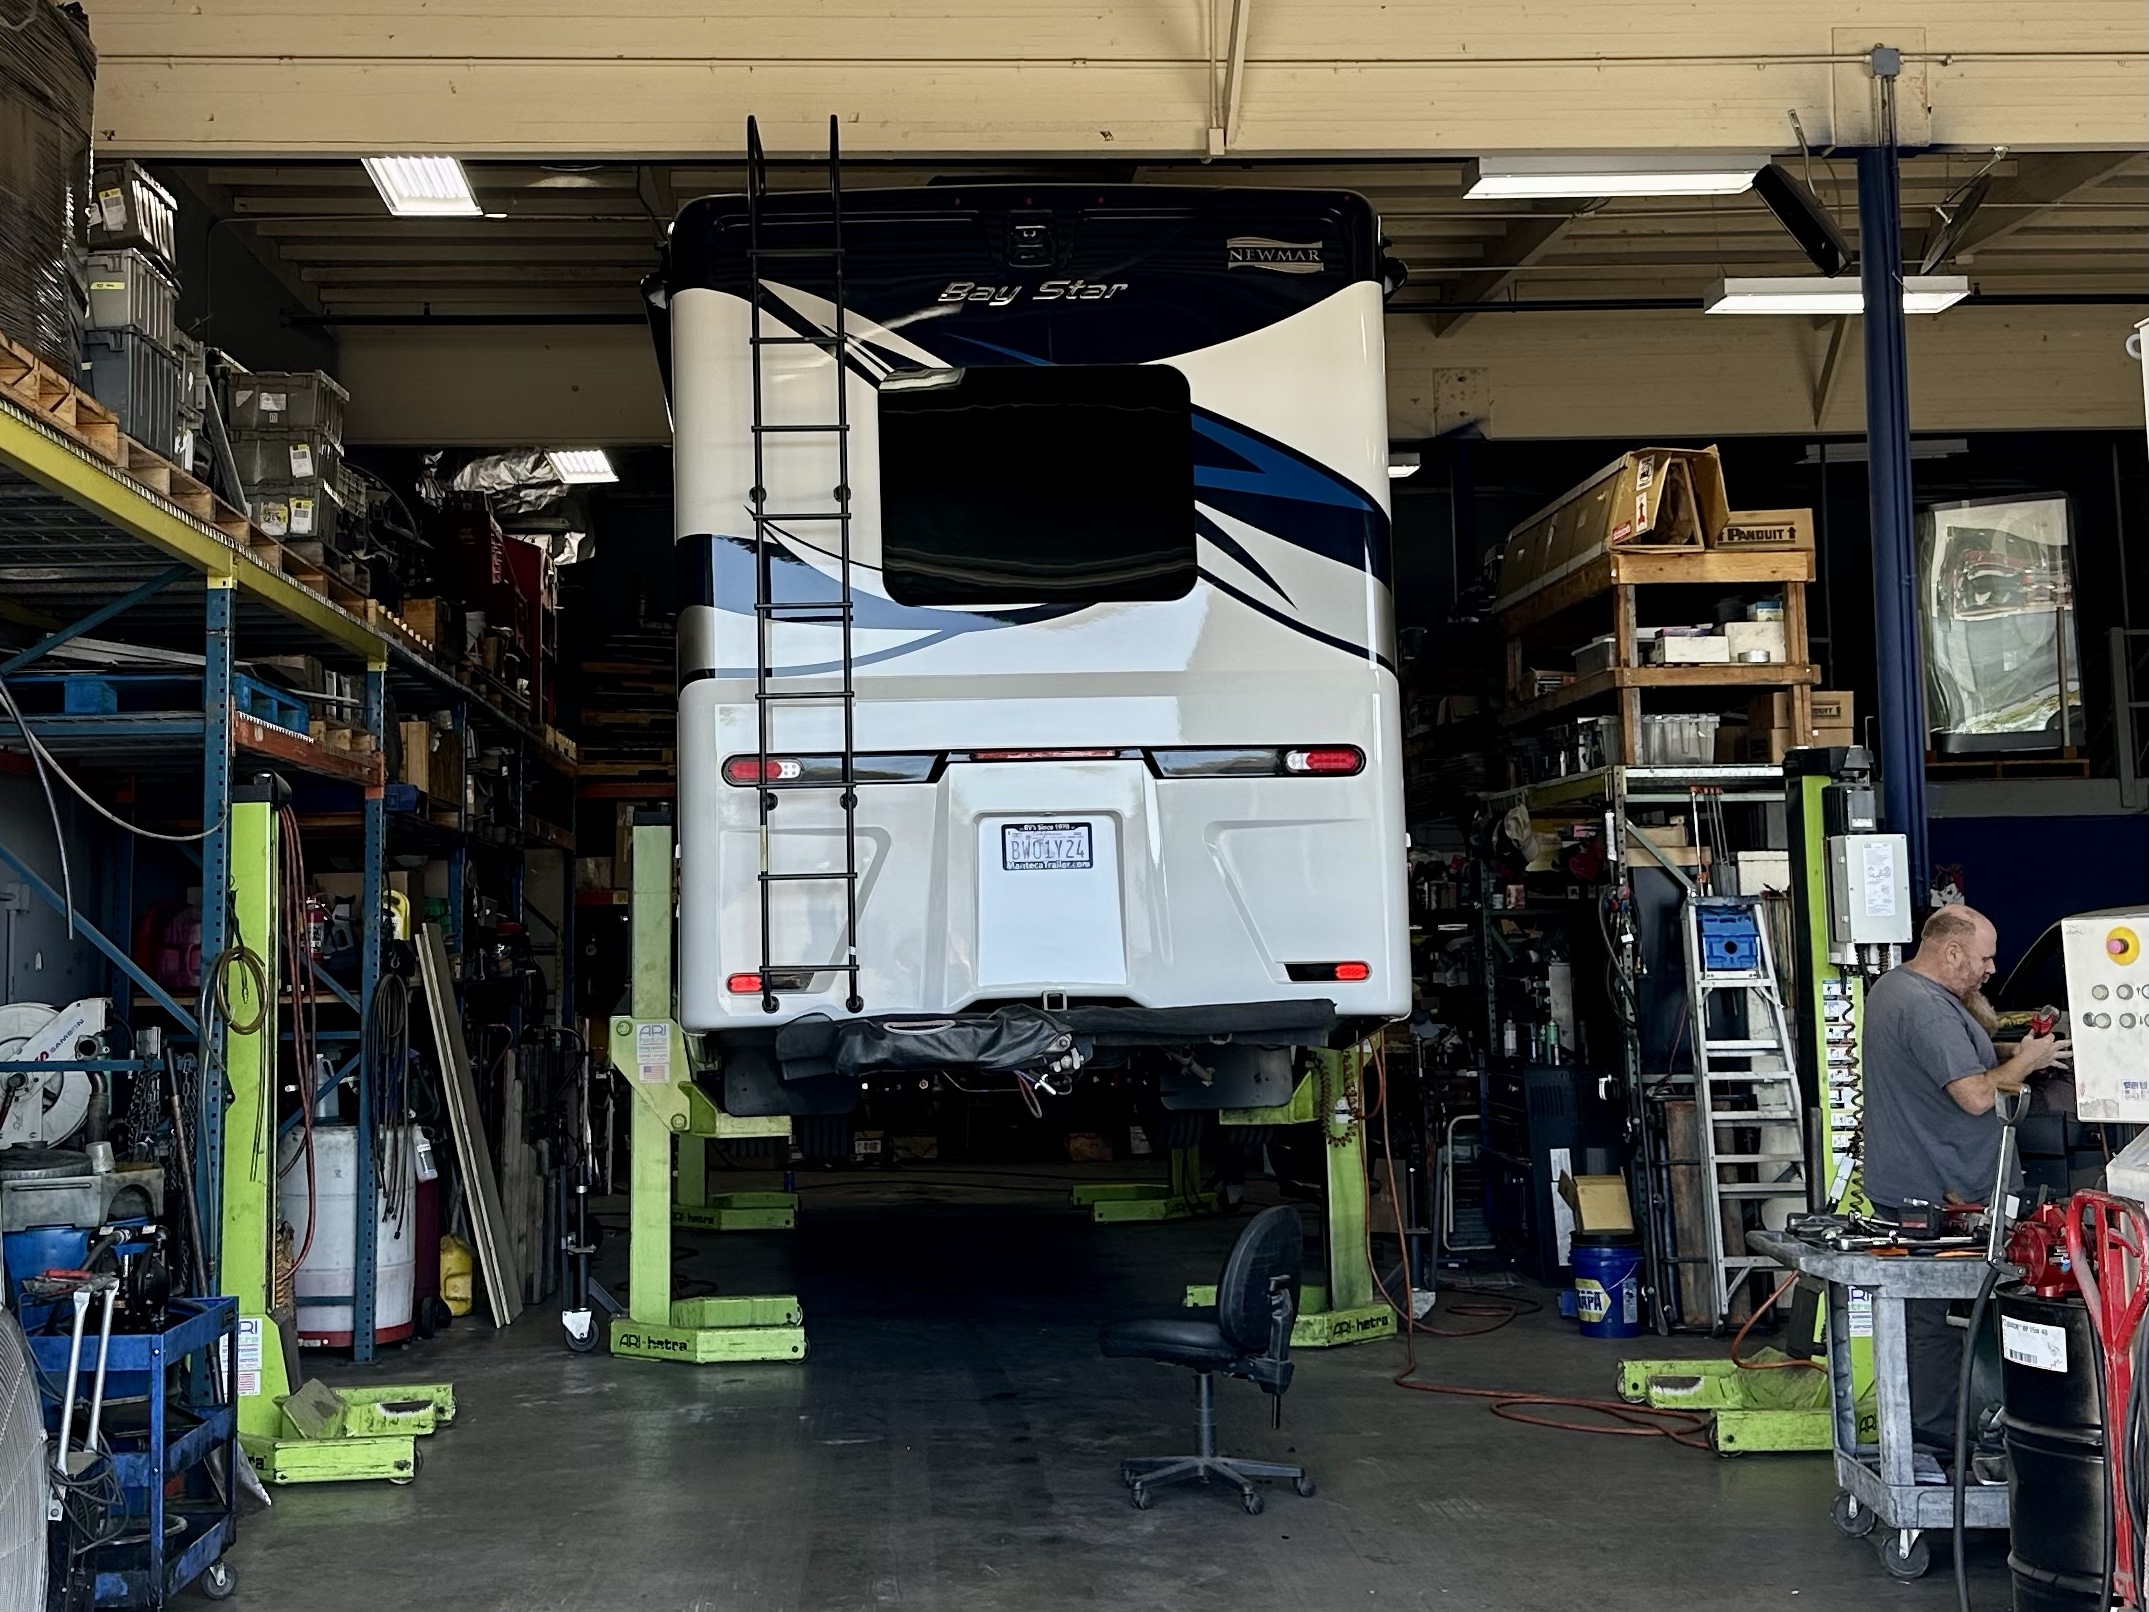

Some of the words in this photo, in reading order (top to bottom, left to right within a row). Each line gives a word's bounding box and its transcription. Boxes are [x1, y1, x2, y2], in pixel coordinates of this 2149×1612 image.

[1229, 249, 1321, 262] NEWMAR
[938, 280, 1022, 306] Bay
[1032, 279, 1129, 301] Star
[1727, 526, 1784, 542] PANDUIT
